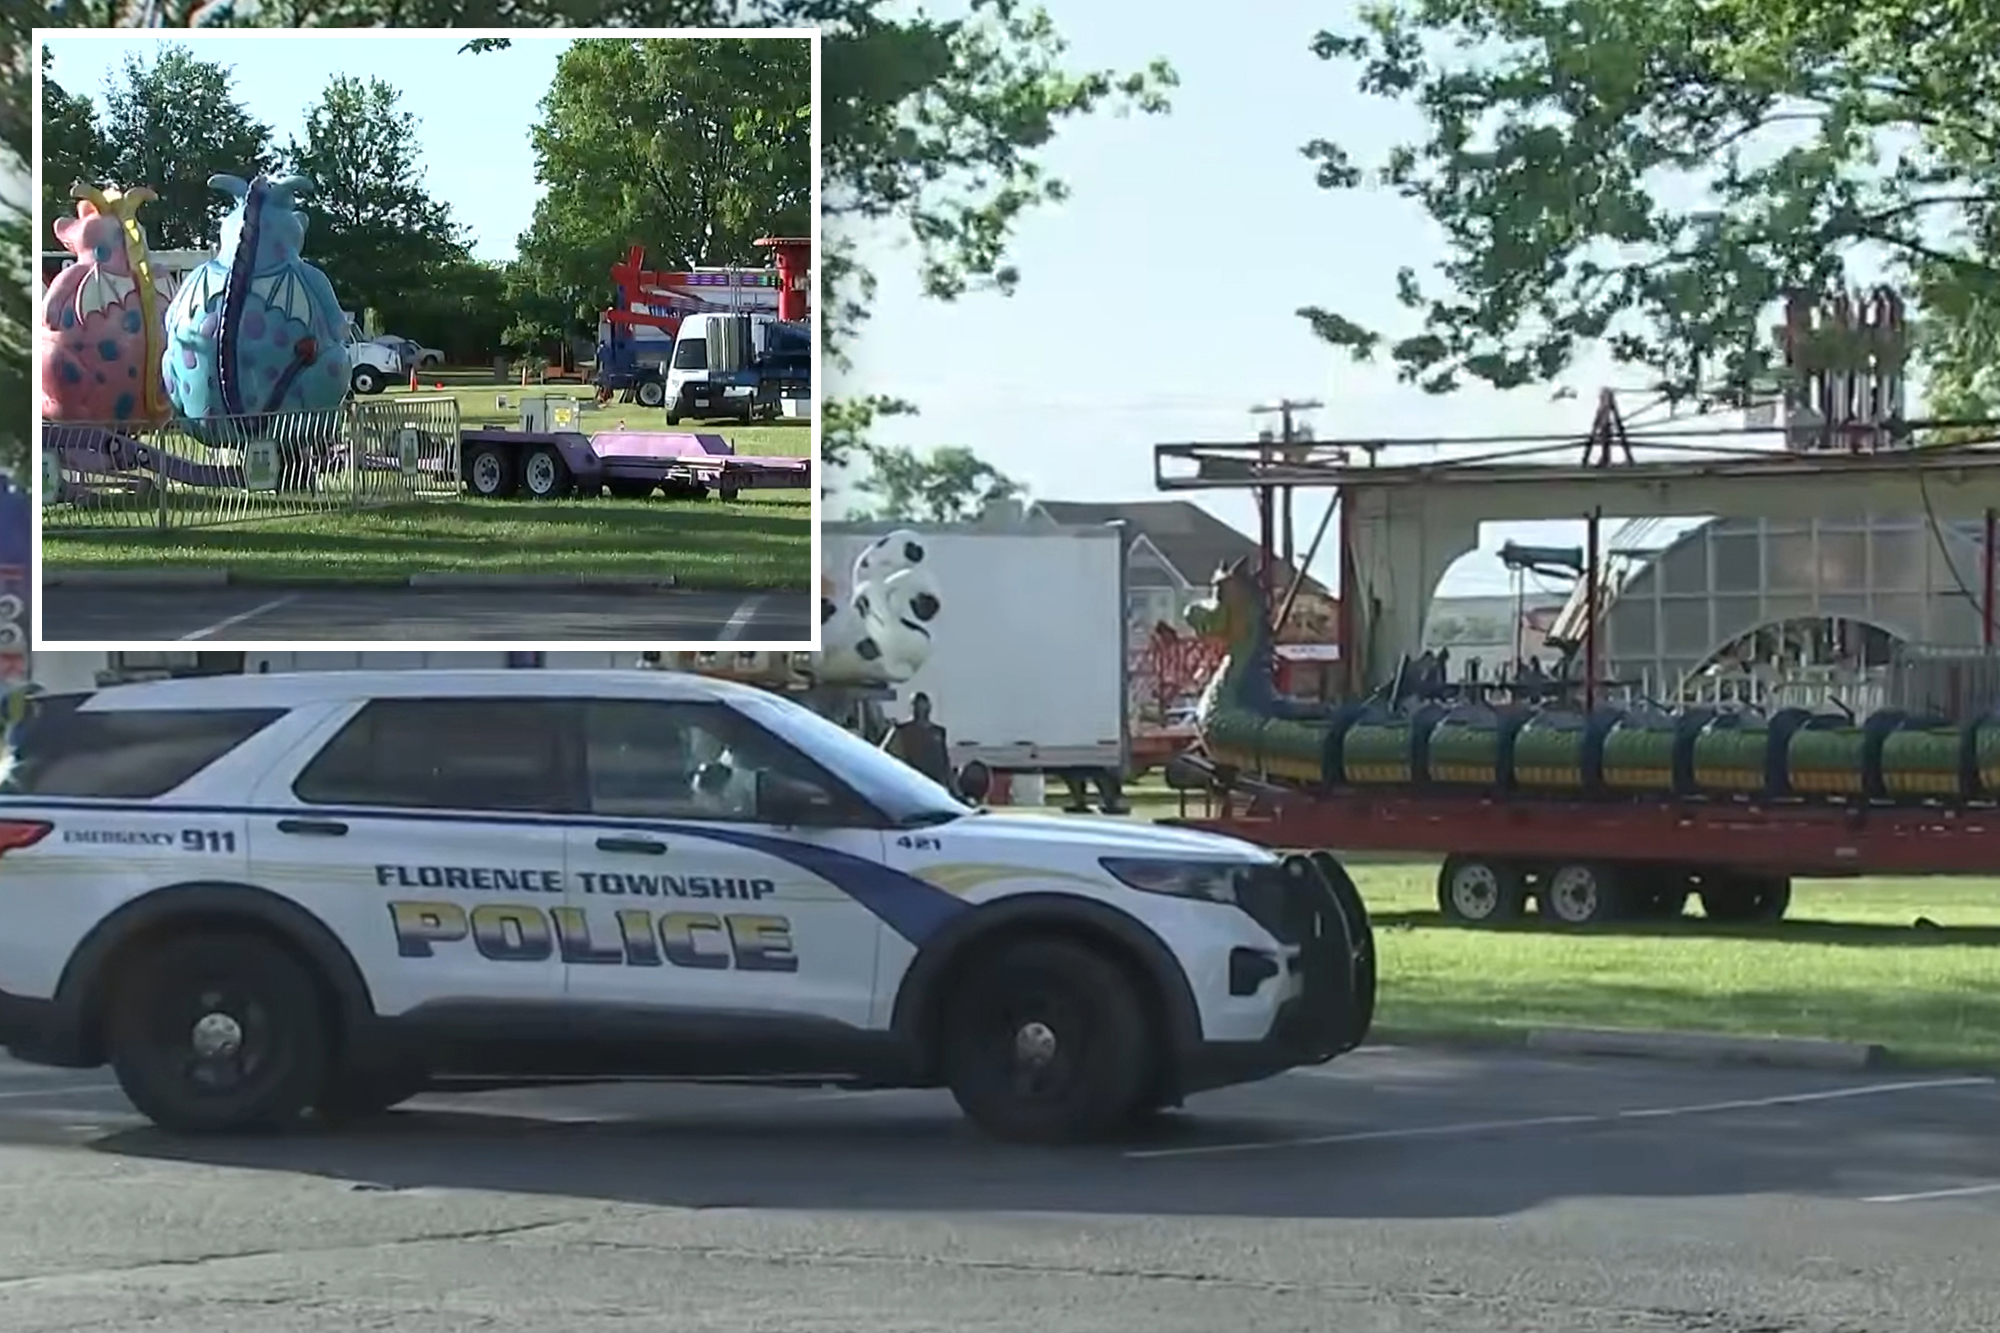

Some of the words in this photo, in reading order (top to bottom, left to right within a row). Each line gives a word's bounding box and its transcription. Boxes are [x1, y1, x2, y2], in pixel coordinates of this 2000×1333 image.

[63, 830, 175, 845] EMERGENCY
[181, 829, 236, 853] 911
[896, 835, 942, 851] 421
[375, 865, 563, 892] FLORENCE
[575, 872, 775, 900] TOWNSHIP
[386, 901, 799, 972] POLICE
